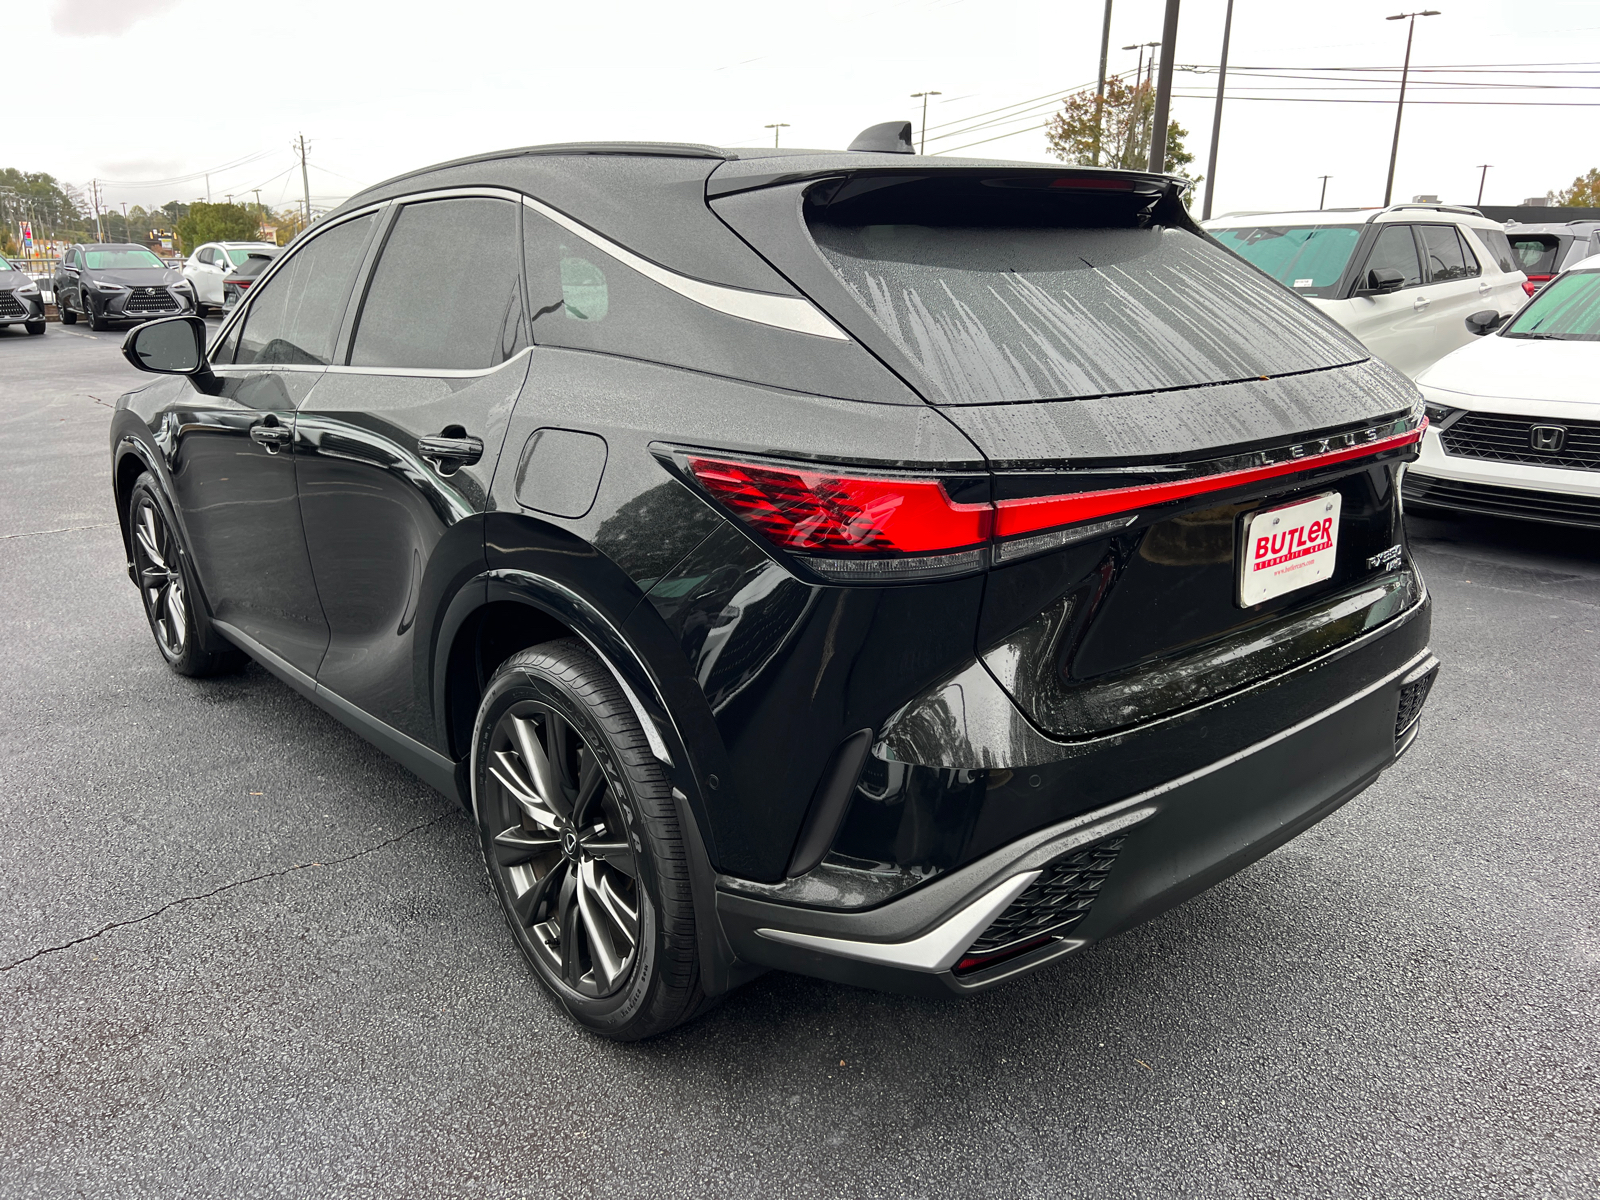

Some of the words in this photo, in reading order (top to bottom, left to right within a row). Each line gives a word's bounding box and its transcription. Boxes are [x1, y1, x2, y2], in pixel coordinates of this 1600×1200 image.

[1260, 429, 1378, 465] LEXUS
[1253, 550, 1304, 571] AUTOMOTIVE
[1310, 541, 1333, 554] GROUP
[1273, 558, 1315, 576] www.butlercars.com
[548, 688, 643, 854] GOODYEAR
